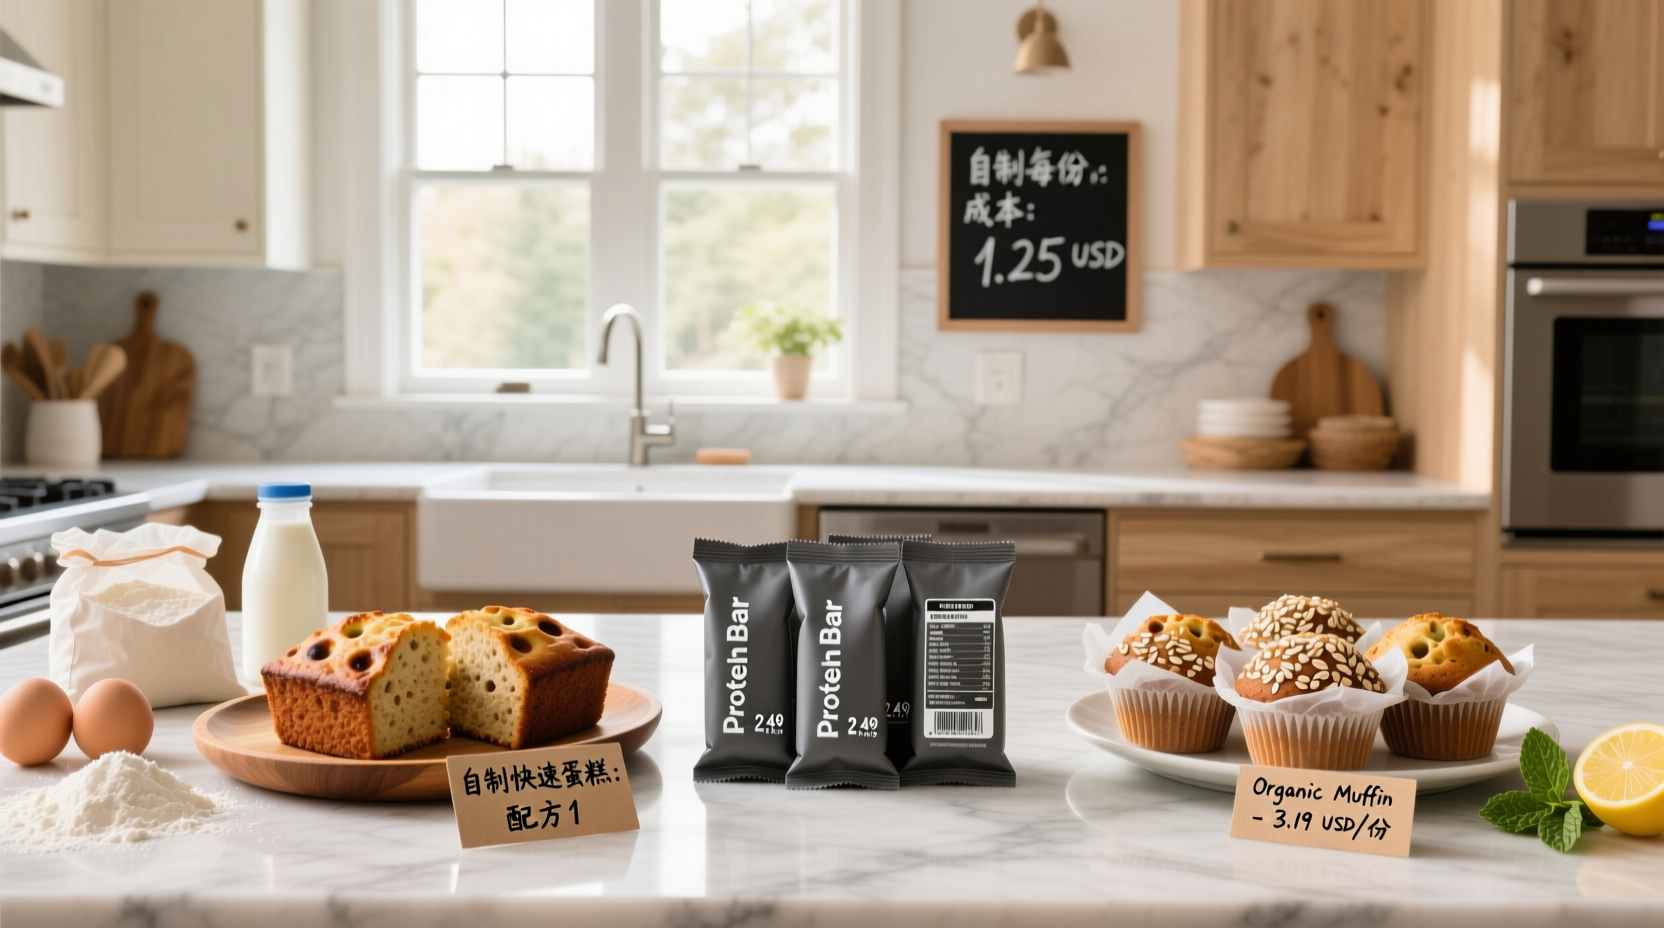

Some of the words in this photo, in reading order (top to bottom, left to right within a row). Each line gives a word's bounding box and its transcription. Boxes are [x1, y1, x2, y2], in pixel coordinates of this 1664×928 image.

[974, 236, 1065, 288] 1.25
[1071, 240, 1125, 269] USD
[726, 596, 749, 642] Bar
[819, 599, 842, 645] Bar
[463, 758, 621, 796] 自制快速蛋糕:
[1252, 776, 1323, 806] Organic
[1333, 784, 1393, 807] Muffin
[1273, 809, 1313, 831] 3.19
